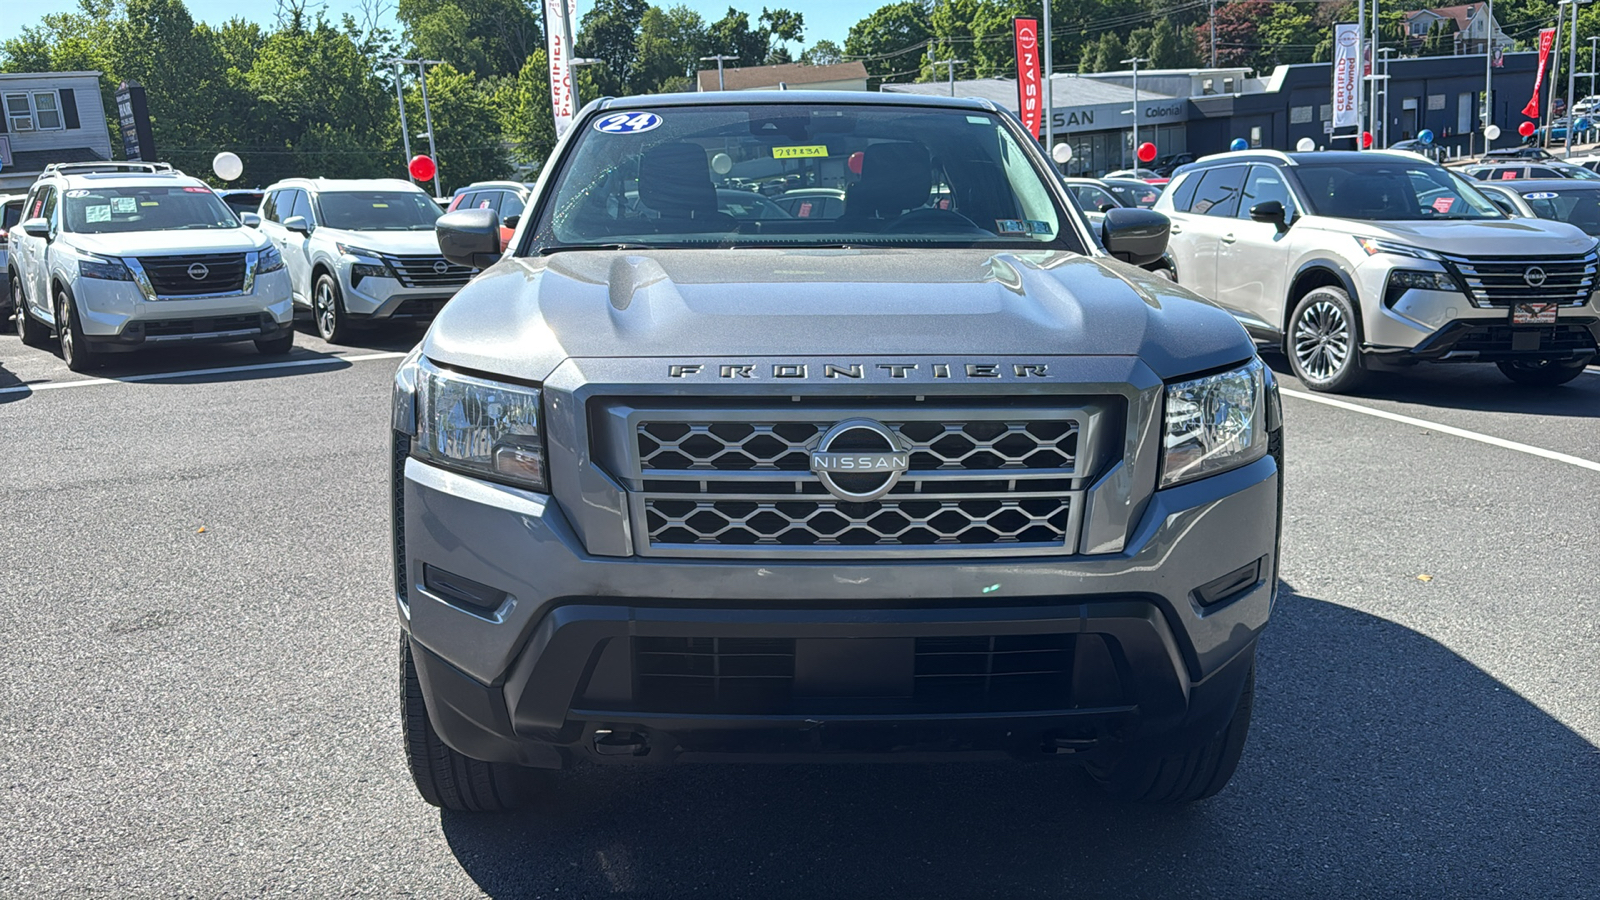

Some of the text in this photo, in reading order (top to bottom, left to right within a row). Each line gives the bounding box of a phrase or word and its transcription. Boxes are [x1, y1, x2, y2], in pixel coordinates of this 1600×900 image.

[553, 35, 561, 117] CERTIFIED
[1024, 53, 1036, 132] NISSAN
[1337, 58, 1346, 112] CERTIFIED
[1345, 57, 1355, 111] Pre-Owned
[602, 113, 650, 132] 24
[1145, 104, 1182, 118] Colonial
[669, 363, 1053, 379] FRONTIER
[814, 456, 906, 469] NISSAN
